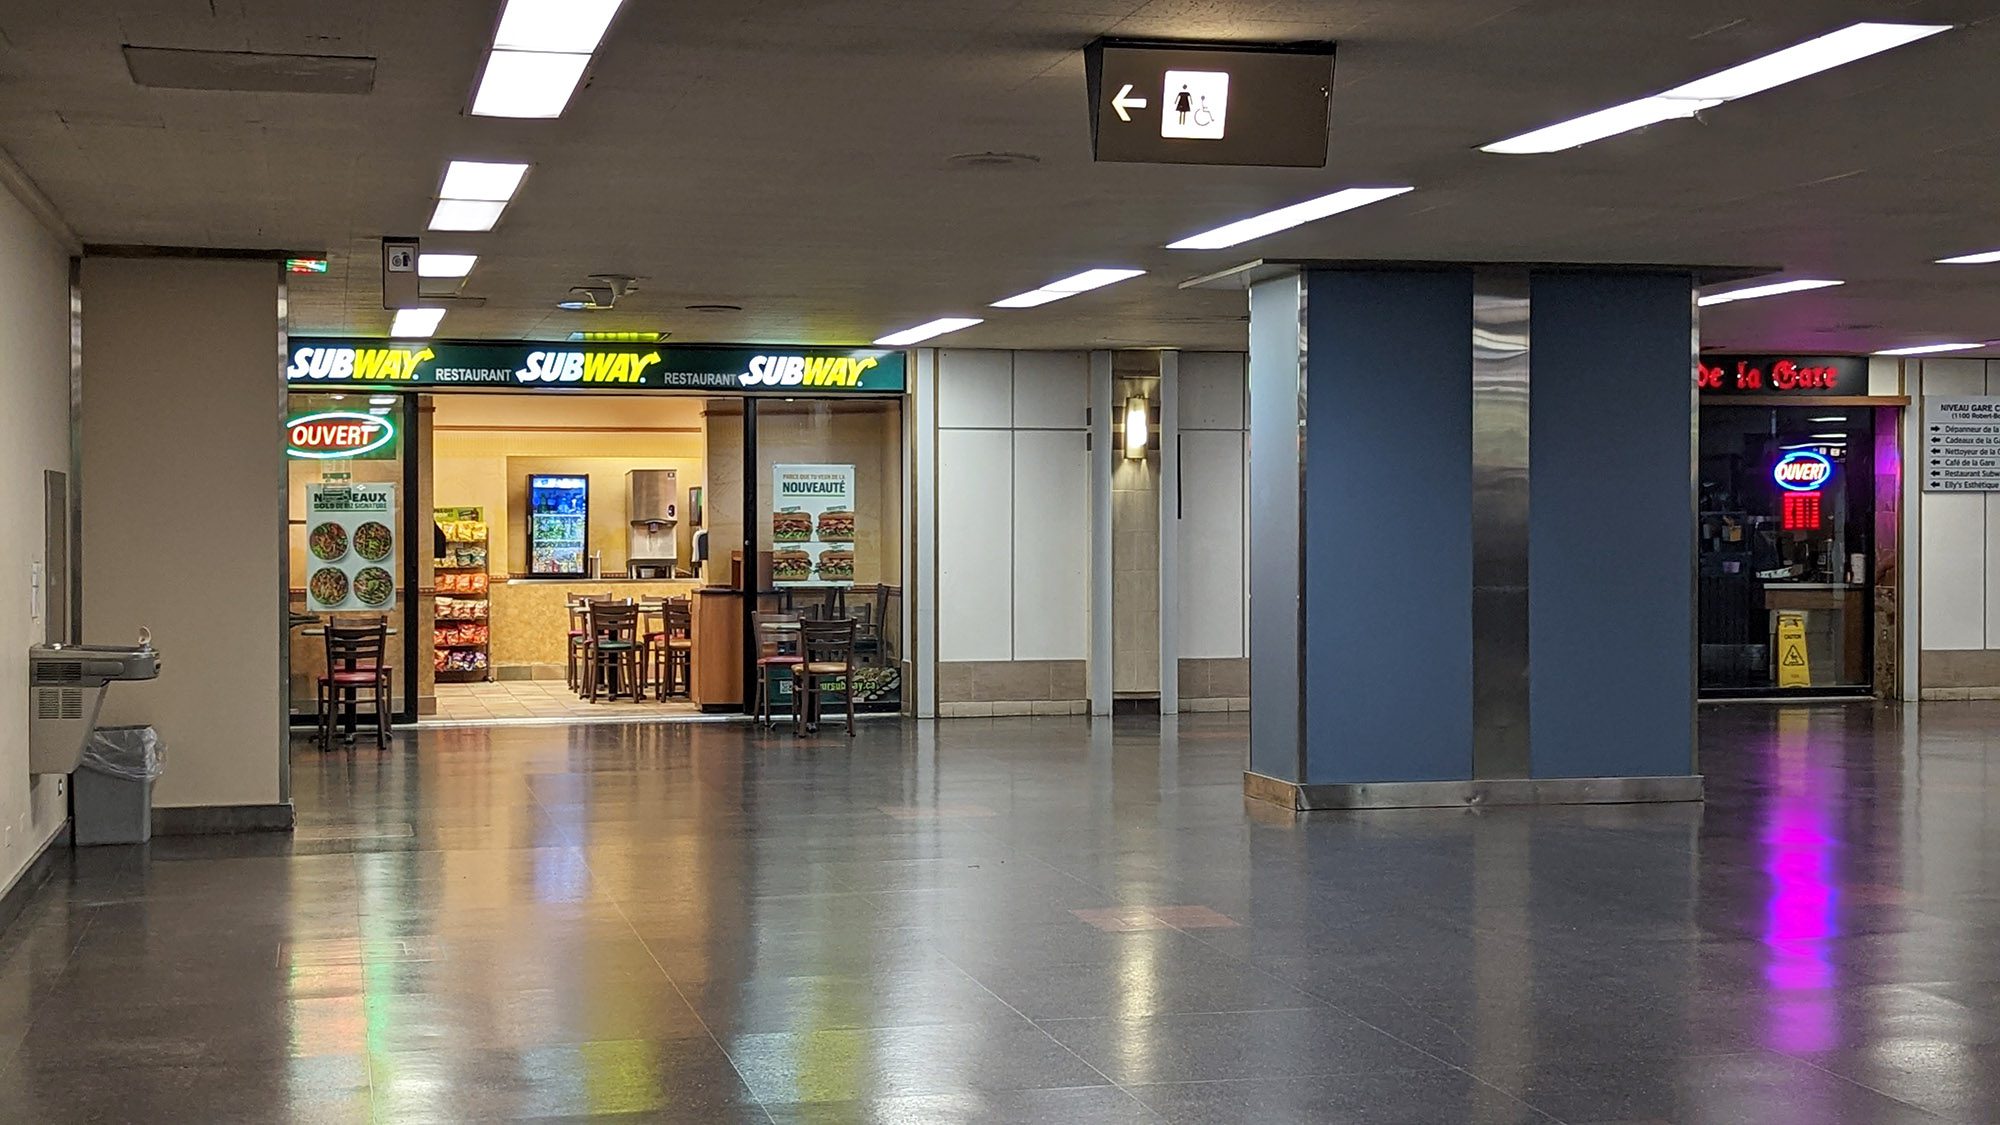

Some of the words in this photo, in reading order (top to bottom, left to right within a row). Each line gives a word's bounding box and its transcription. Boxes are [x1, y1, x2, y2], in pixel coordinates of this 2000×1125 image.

[287, 347, 435, 380] SUBWAY
[515, 351, 661, 383] SUBWAY
[435, 368, 511, 382] RESTAURANT
[738, 355, 878, 386] SUBWAY
[1736, 360, 1762, 389] la
[1772, 359, 1839, 390] Gare
[664, 372, 736, 385] RESTAURANT
[1941, 404, 1969, 412] NIVEAU
[1971, 404, 1993, 412] GARE
[292, 425, 375, 446] OUVERT
[1945, 425, 1981, 433] Dépanneur
[1945, 448, 1978, 457] Nettoyeur
[1776, 463, 1826, 481] OUVERT
[782, 480, 846, 493] NOUVEAUTÉ
[1945, 481, 1962, 489] Elly's
[314, 493, 387, 502] NEAUX
